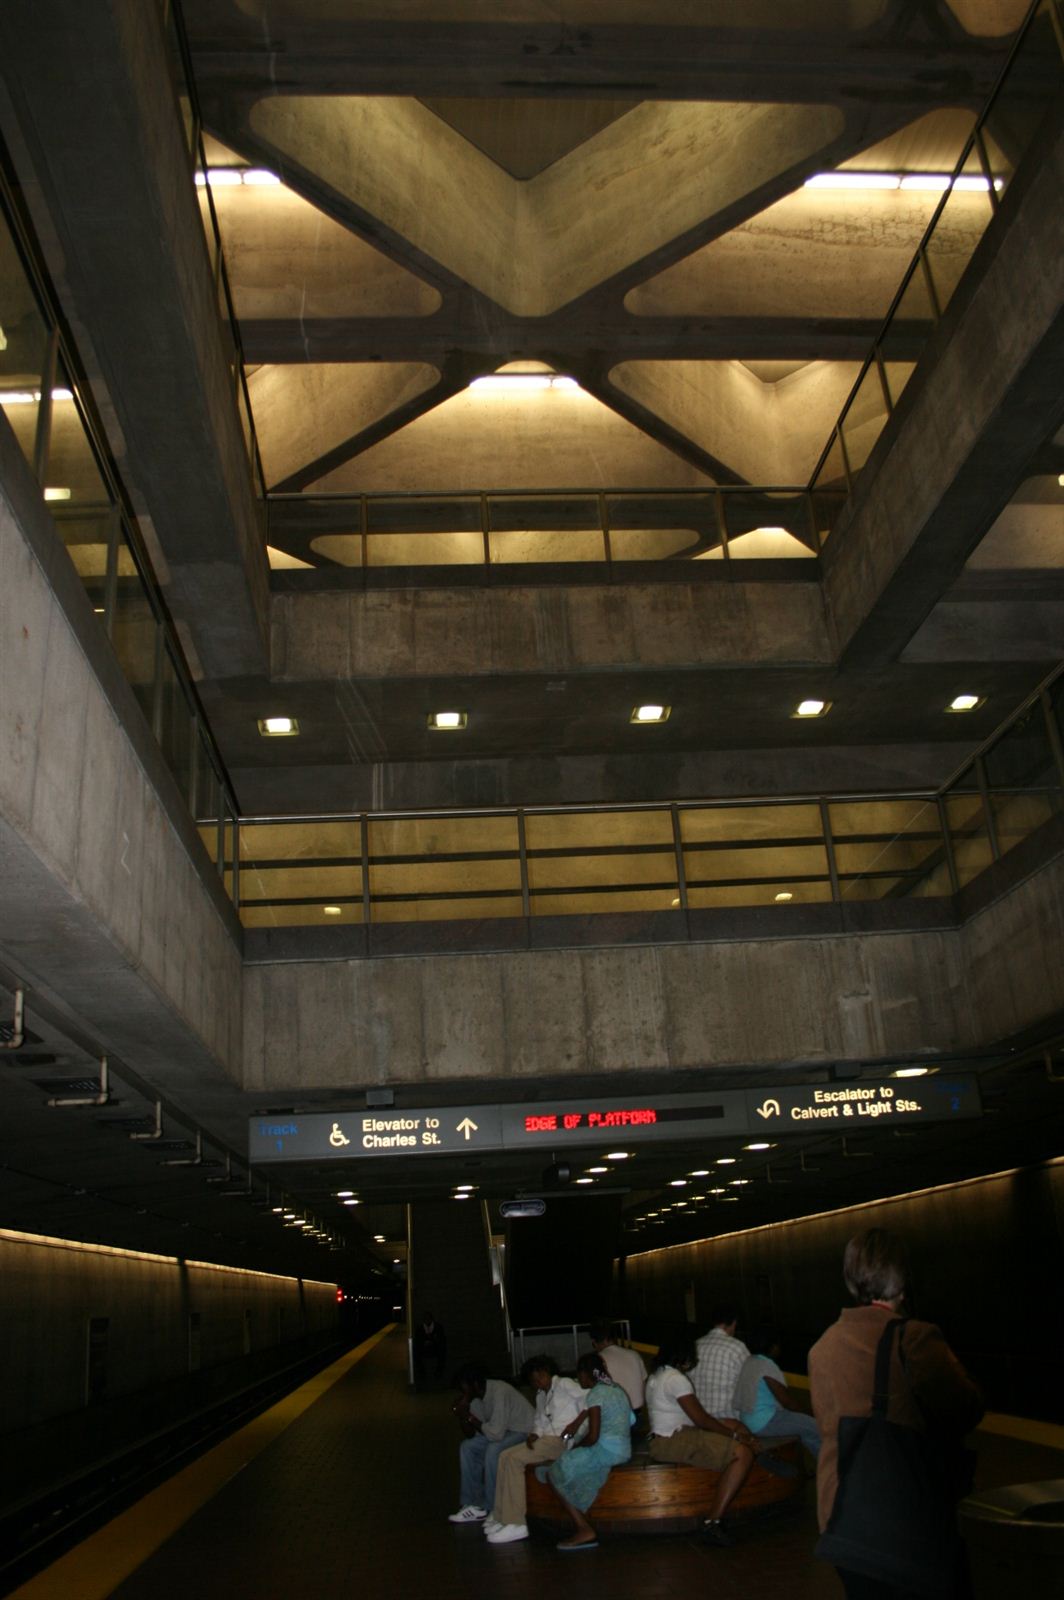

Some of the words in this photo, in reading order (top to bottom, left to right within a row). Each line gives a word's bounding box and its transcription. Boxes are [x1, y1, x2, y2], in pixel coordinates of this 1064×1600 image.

[814, 1087, 875, 1103] Escalator
[880, 1086, 894, 1098] to
[790, 1104, 838, 1120] Calvert
[842, 1103, 854, 1116] &
[857, 1100, 892, 1117] Light
[895, 1098, 923, 1112] Sts.
[259, 1121, 298, 1136] Track
[362, 1117, 419, 1132] Elevator
[425, 1117, 440, 1129] to
[525, 1115, 558, 1132] EDGE
[563, 1113, 582, 1129] OF
[588, 1108, 656, 1127] PLATFORM
[362, 1132, 416, 1148] Charles
[422, 1131, 442, 1145] St.
